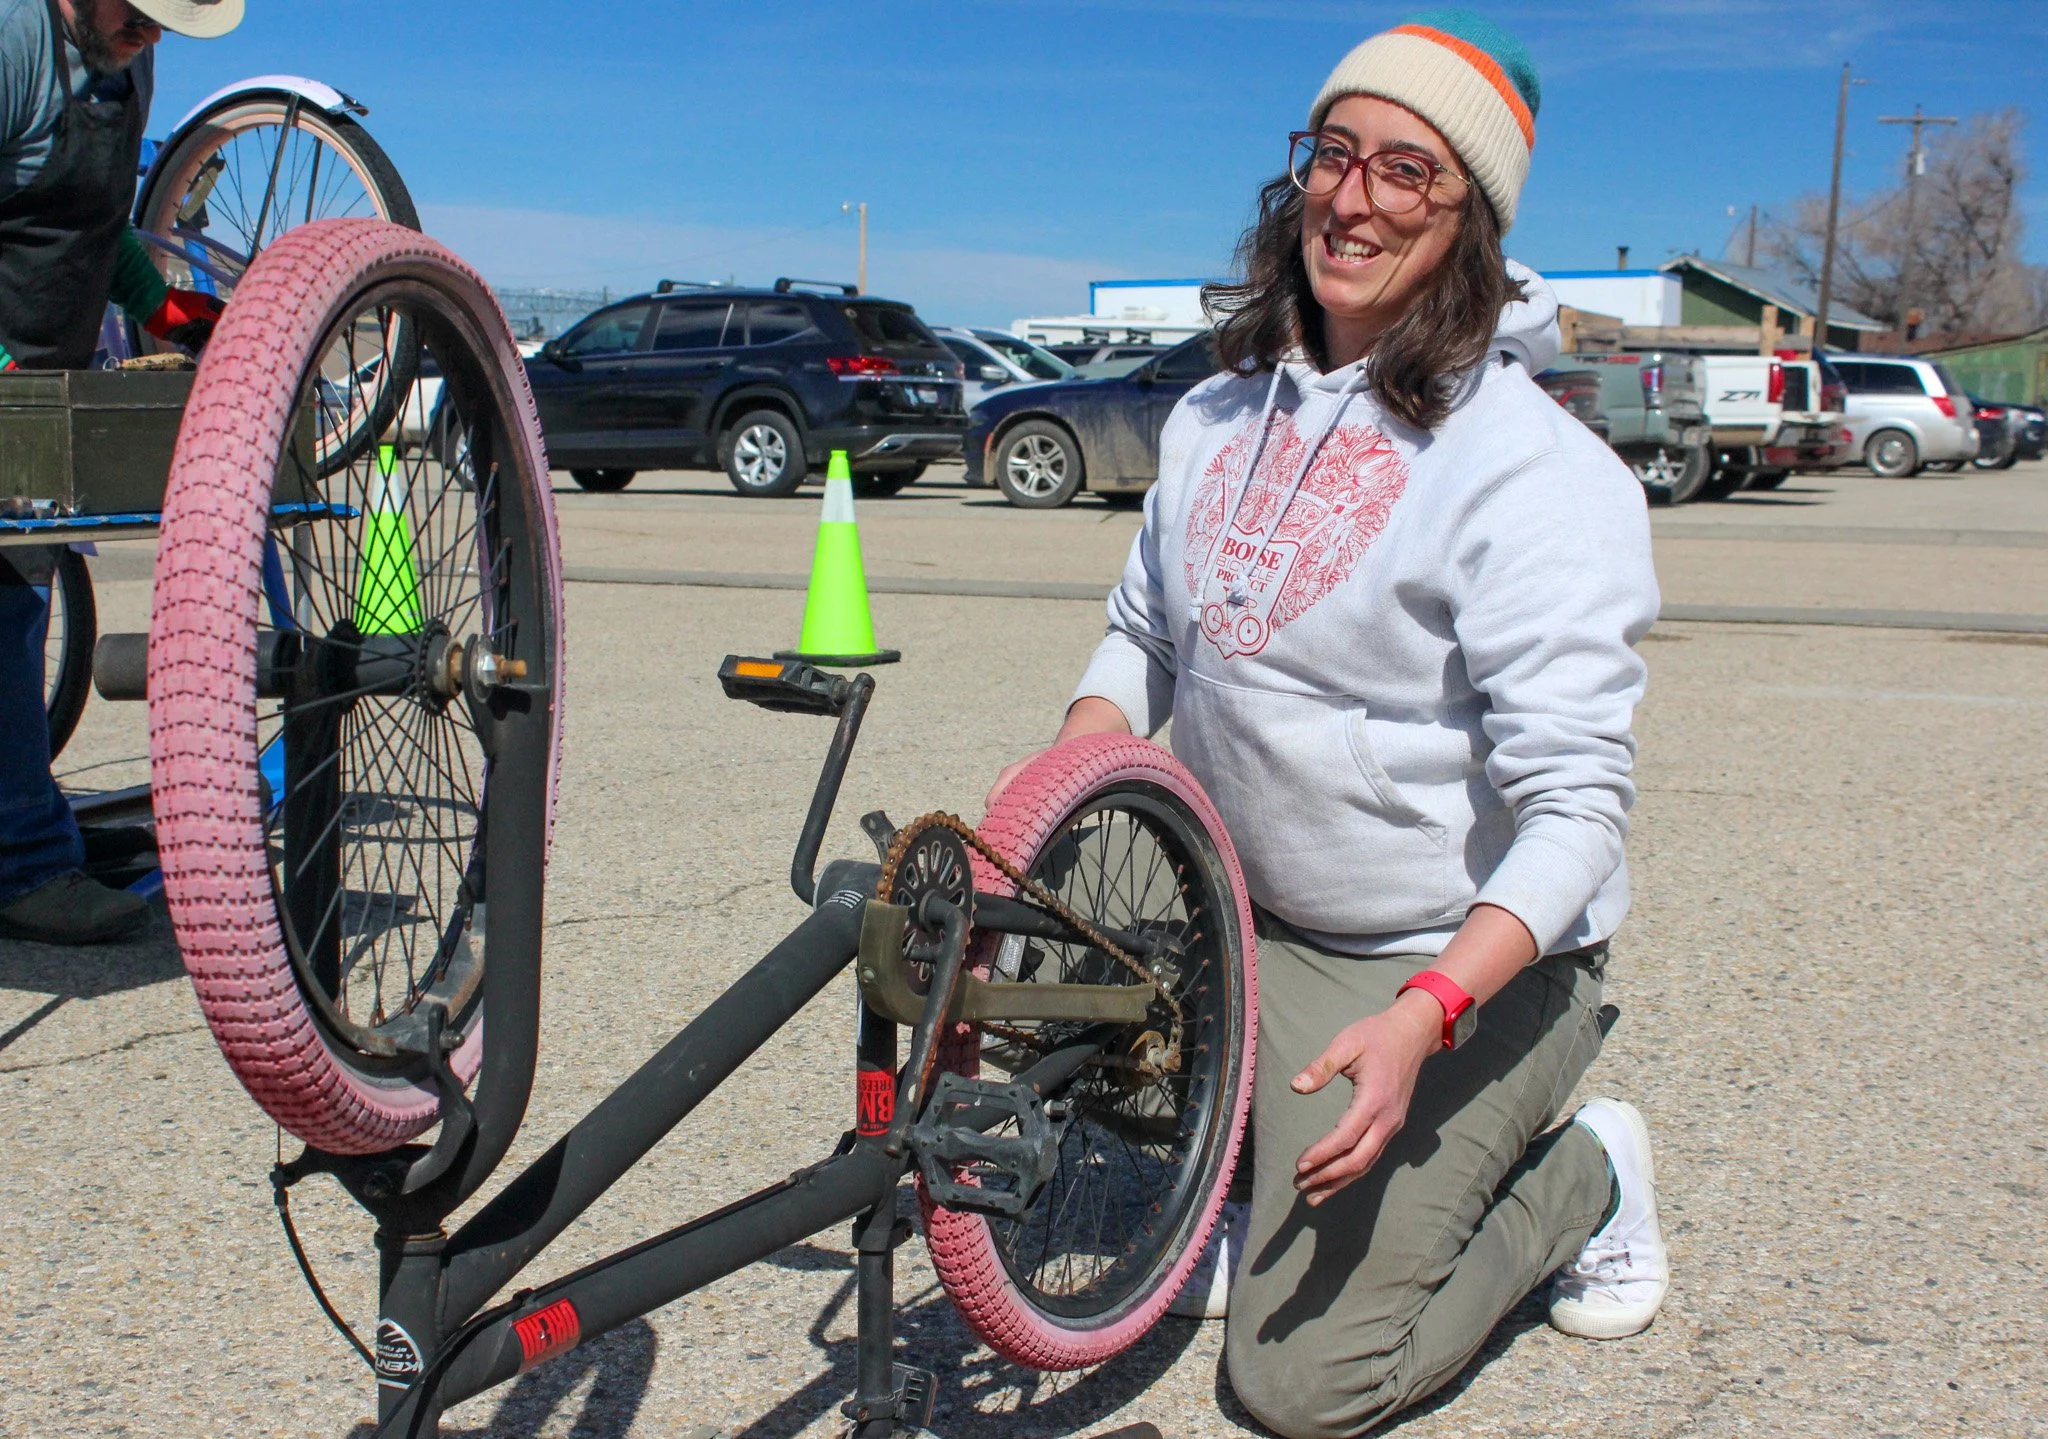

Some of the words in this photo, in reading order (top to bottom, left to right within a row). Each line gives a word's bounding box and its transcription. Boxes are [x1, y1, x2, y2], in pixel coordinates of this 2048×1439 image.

[1221, 536, 1284, 570] BOISE
[1216, 568, 1268, 593] PROCT
[857, 1091, 895, 1123] BM
